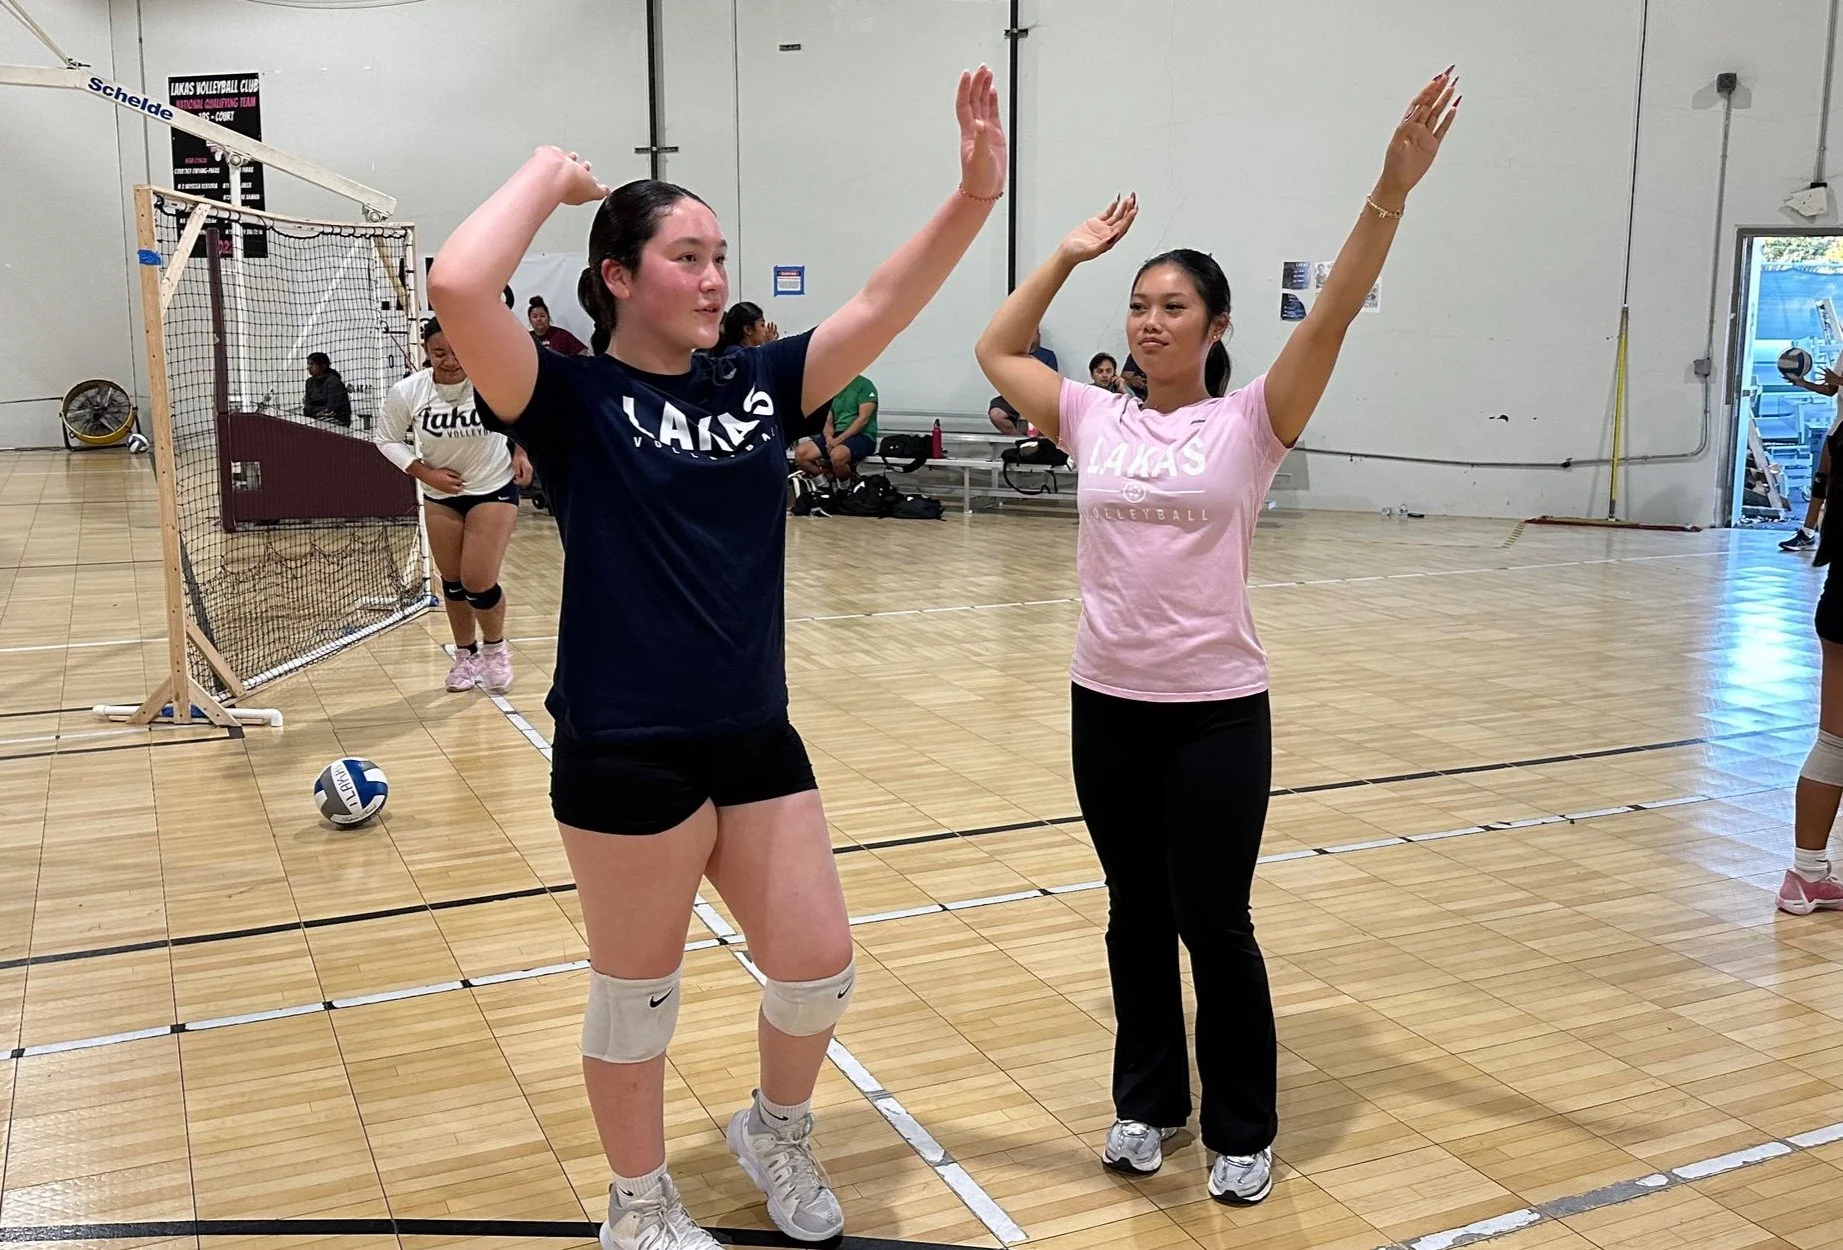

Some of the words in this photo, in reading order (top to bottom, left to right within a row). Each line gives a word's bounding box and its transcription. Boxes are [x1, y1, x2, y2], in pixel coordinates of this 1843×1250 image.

[88, 77, 173, 120] Schelde
[170, 82, 195, 96] LAKAS
[196, 80, 239, 95] VOLLEYBALL
[240, 78, 259, 93] CLUB
[175, 99, 203, 110] NATIONAL
[204, 97, 239, 109] QUALIFYING
[240, 96, 256, 107] TEAM
[215, 110, 234, 121] COURT
[418, 406, 481, 437] Laka
[622, 382, 774, 451] LAKAS
[1087, 435, 1206, 476] LAKAS
